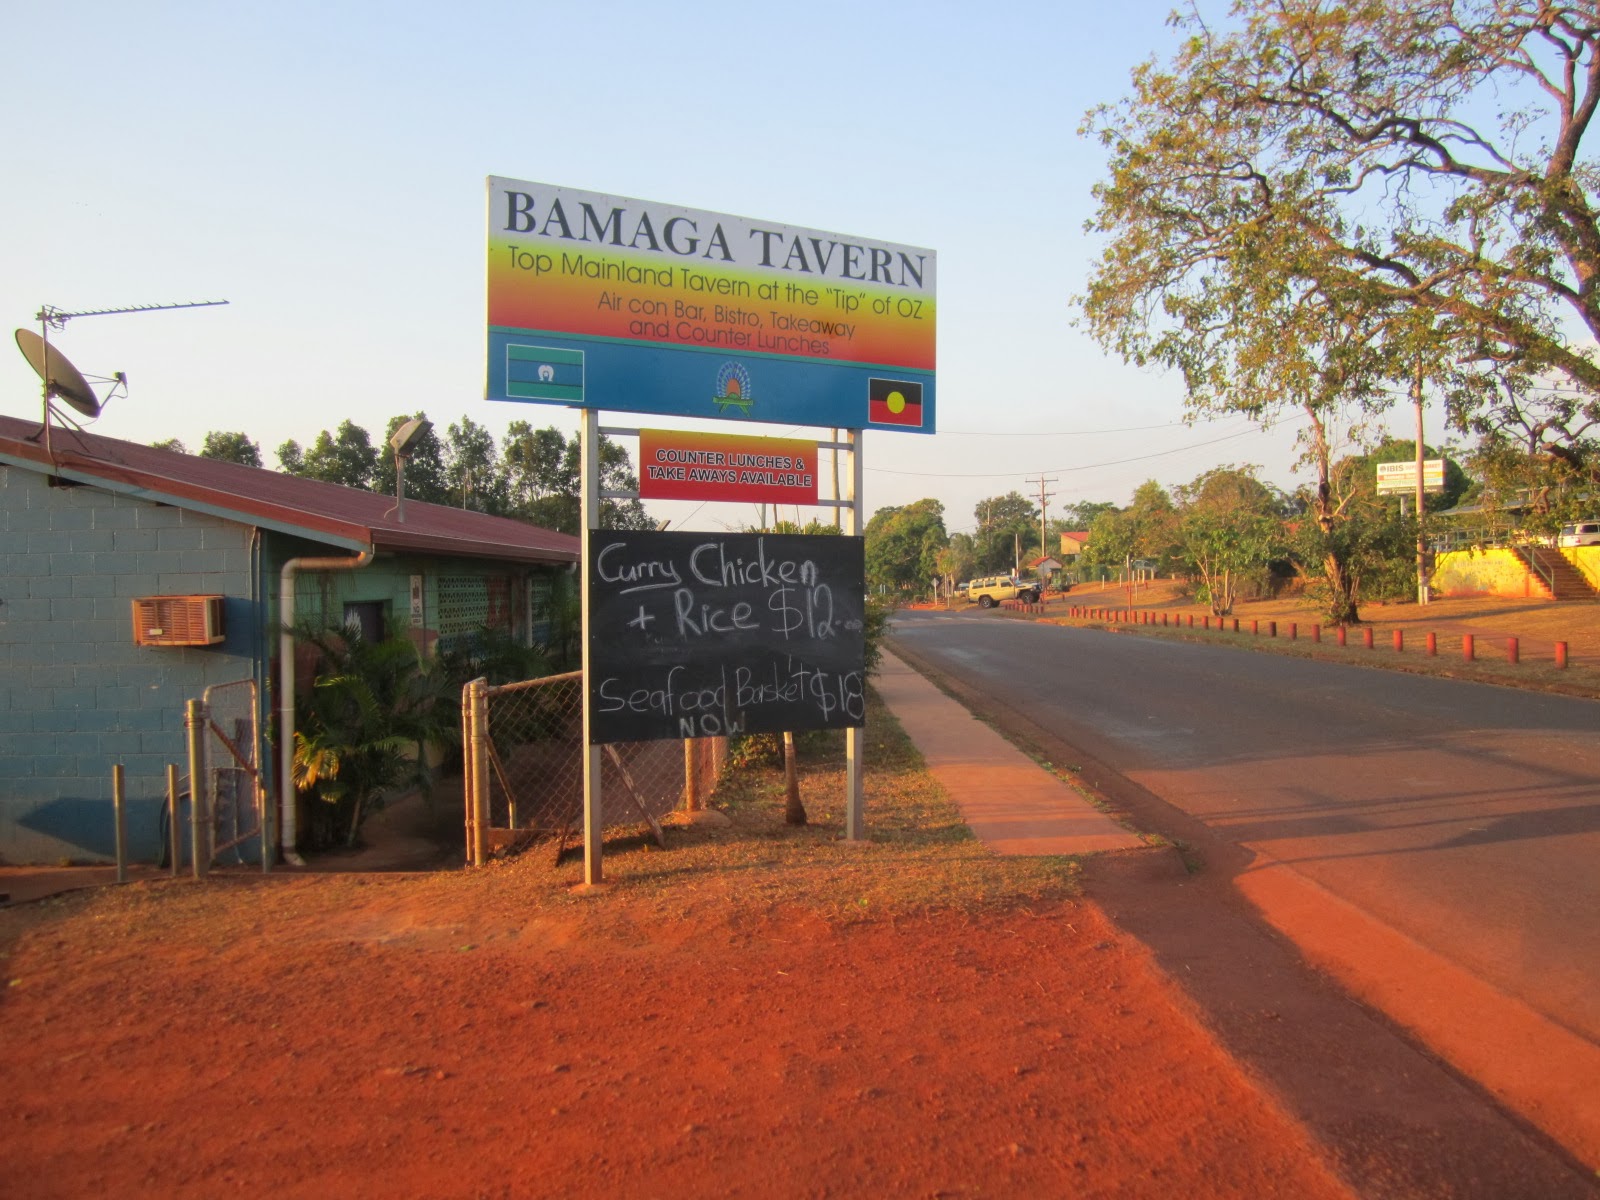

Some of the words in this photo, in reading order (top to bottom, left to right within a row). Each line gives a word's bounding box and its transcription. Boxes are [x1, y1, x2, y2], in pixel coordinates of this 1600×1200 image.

[504, 190, 736, 262] BAMAGA
[750, 229, 926, 289] TAVERN
[508, 245, 552, 276] Top
[562, 252, 673, 288] Mainland
[681, 268, 750, 297] Tavern
[757, 280, 779, 301] at
[785, 282, 819, 306] the
[826, 287, 866, 314] "Tip"
[872, 296, 891, 315] of
[897, 298, 923, 319] OZ
[598, 291, 622, 311] Air
[629, 298, 667, 317] con
[674, 300, 707, 322] Bar,
[714, 304, 763, 332] Bistro,
[769, 311, 856, 340] Takeaway
[630, 320, 669, 338] and
[676, 321, 751, 346] Counter
[757, 330, 830, 355] Lunches
[648, 466, 686, 481] TAKE
[688, 468, 737, 483] AWAYS
[739, 472, 812, 487] AVAILABLE
[656, 449, 726, 466] COUNTER
[729, 454, 792, 470] LUNCHES
[795, 458, 805, 471] &
[1386, 464, 1404, 472] IBIS
[597, 543, 682, 594] Curry
[690, 537, 818, 588] Chicken
[627, 604, 655, 630] +
[673, 588, 760, 640] Rice
[598, 664, 726, 716] Seafood
[810, 668, 865, 722] $18
[679, 710, 746, 738] NOW
